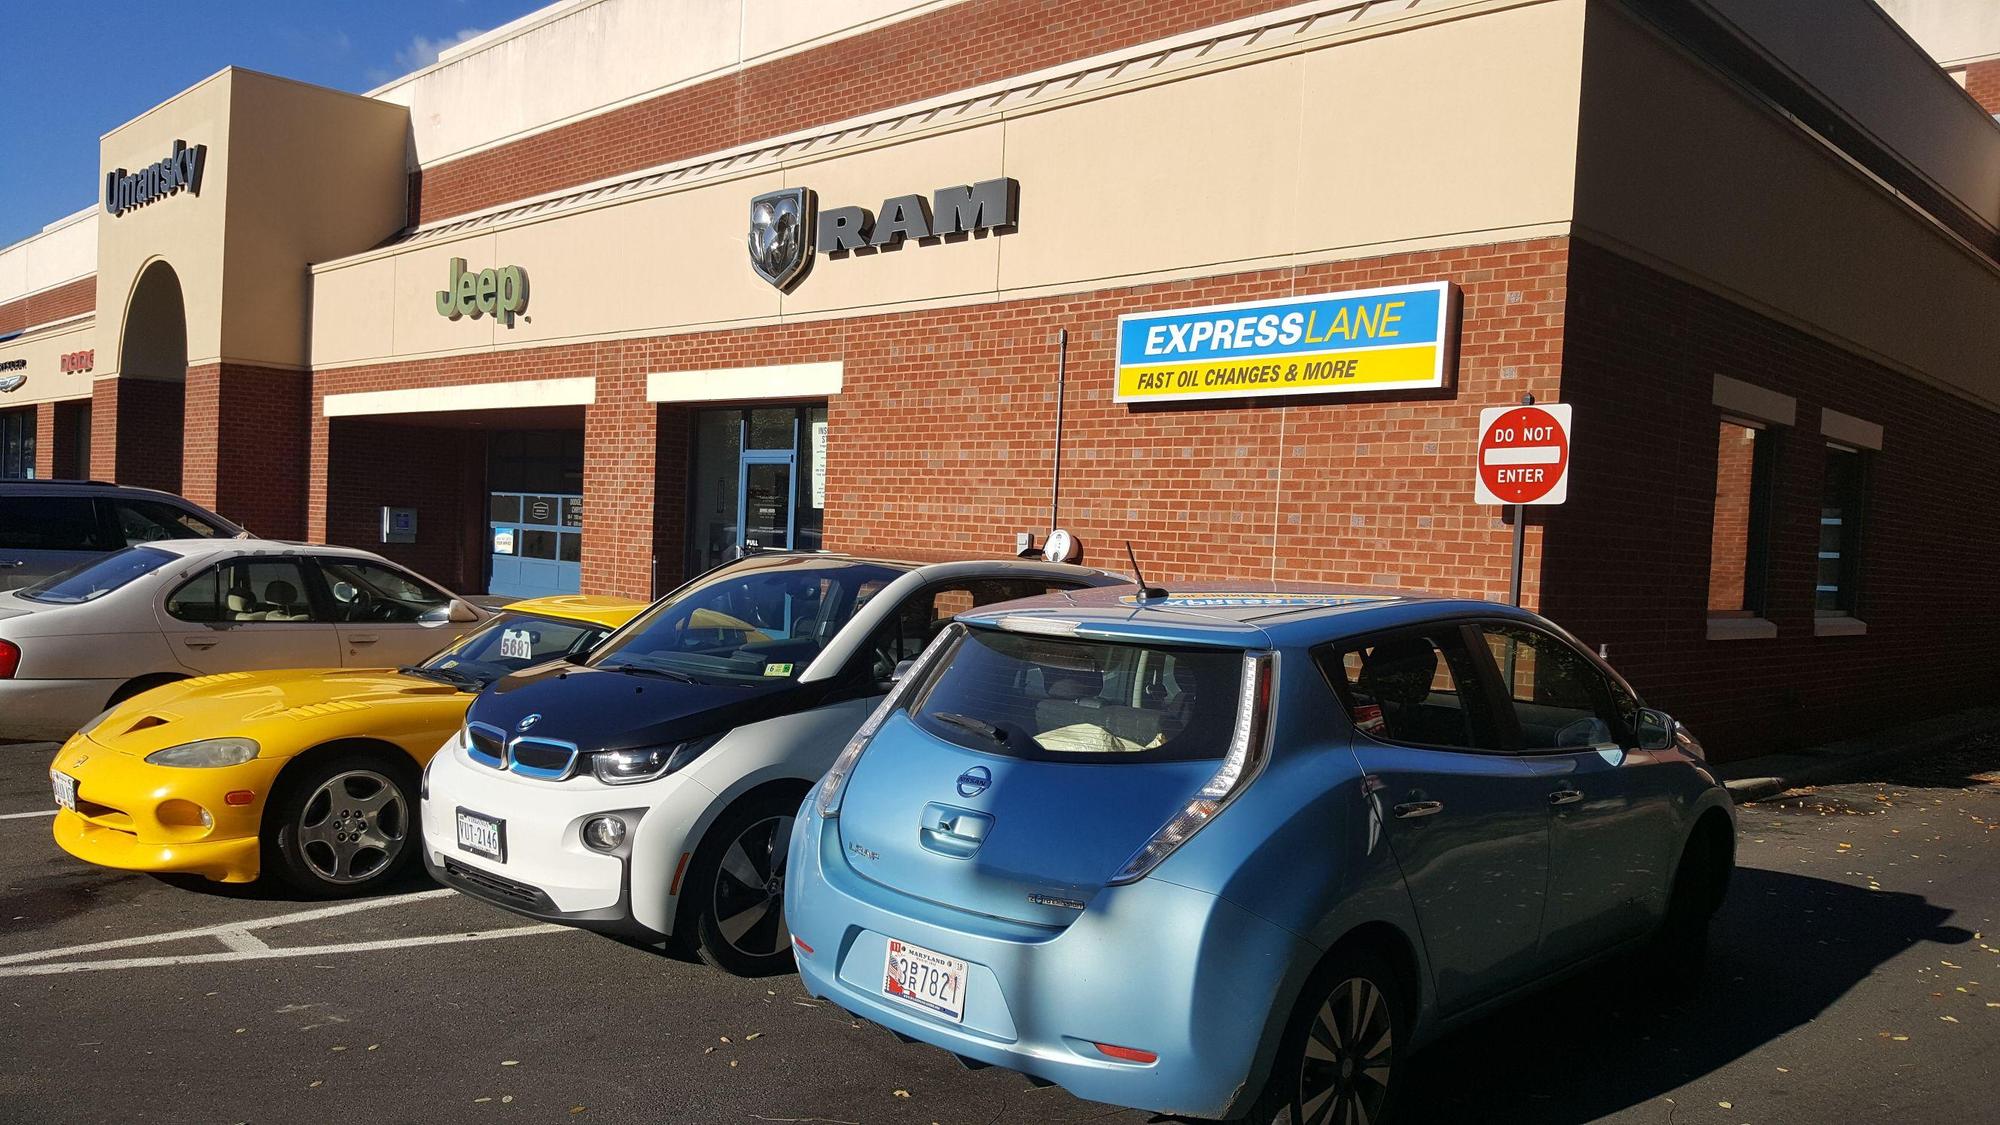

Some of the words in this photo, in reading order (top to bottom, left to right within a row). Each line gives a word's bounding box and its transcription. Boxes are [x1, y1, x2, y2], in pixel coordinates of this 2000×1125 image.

[106, 139, 207, 216] Umansky
[818, 177, 1019, 257] RAM
[436, 257, 530, 326] Jeep
[1137, 371, 1175, 390] FAST
[1177, 369, 1199, 387] OIL
[1204, 364, 1281, 385] CHANGES
[1284, 364, 1298, 382] &
[1303, 360, 1358, 380] MORE
[1495, 428, 1514, 443] DO
[1523, 426, 1553, 442] NOT
[1497, 468, 1544, 483] ENTER
[746, 539, 758, 547] PULL
[502, 639, 530, 658] 5687
[459, 820, 498, 850] VUT-2146
[909, 949, 946, 966] MARYLAND
